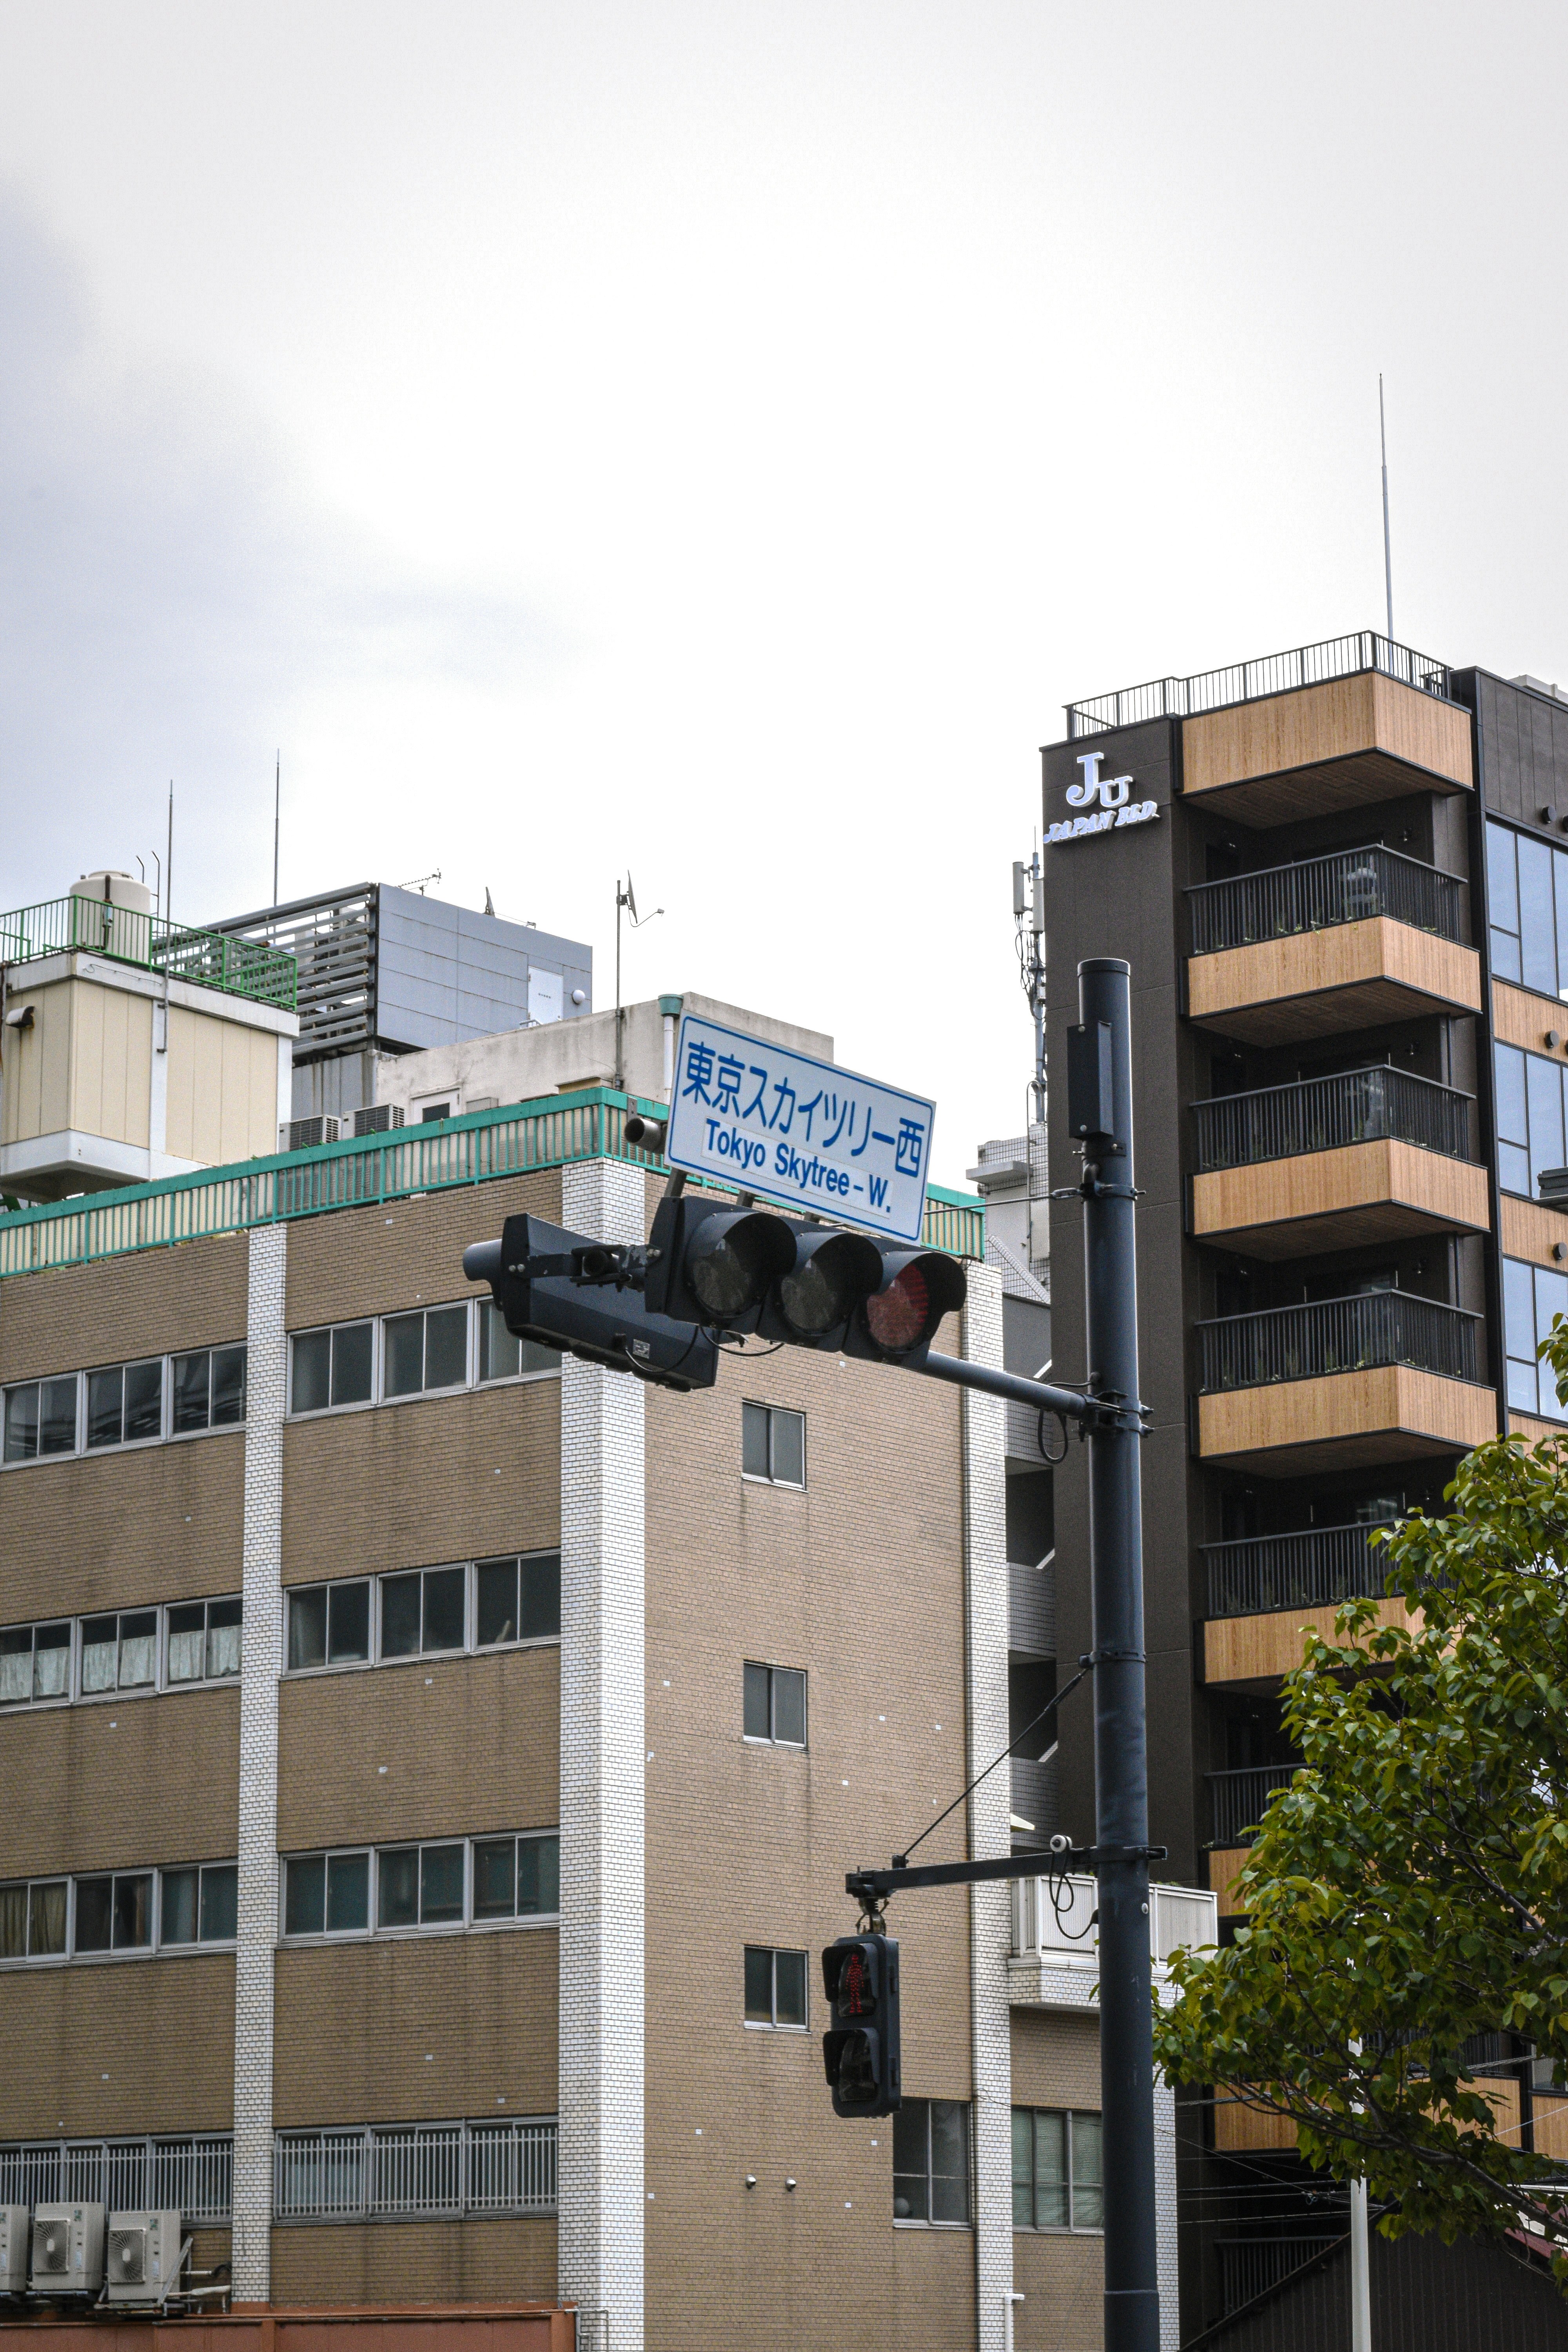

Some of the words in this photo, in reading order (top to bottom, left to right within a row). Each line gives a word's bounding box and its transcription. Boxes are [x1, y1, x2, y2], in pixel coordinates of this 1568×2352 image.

[1043, 810, 1116, 844] JAPAN
[682, 1042, 925, 1178] 東京スカイツリー西
[706, 1118, 766, 1169] Tokyo
